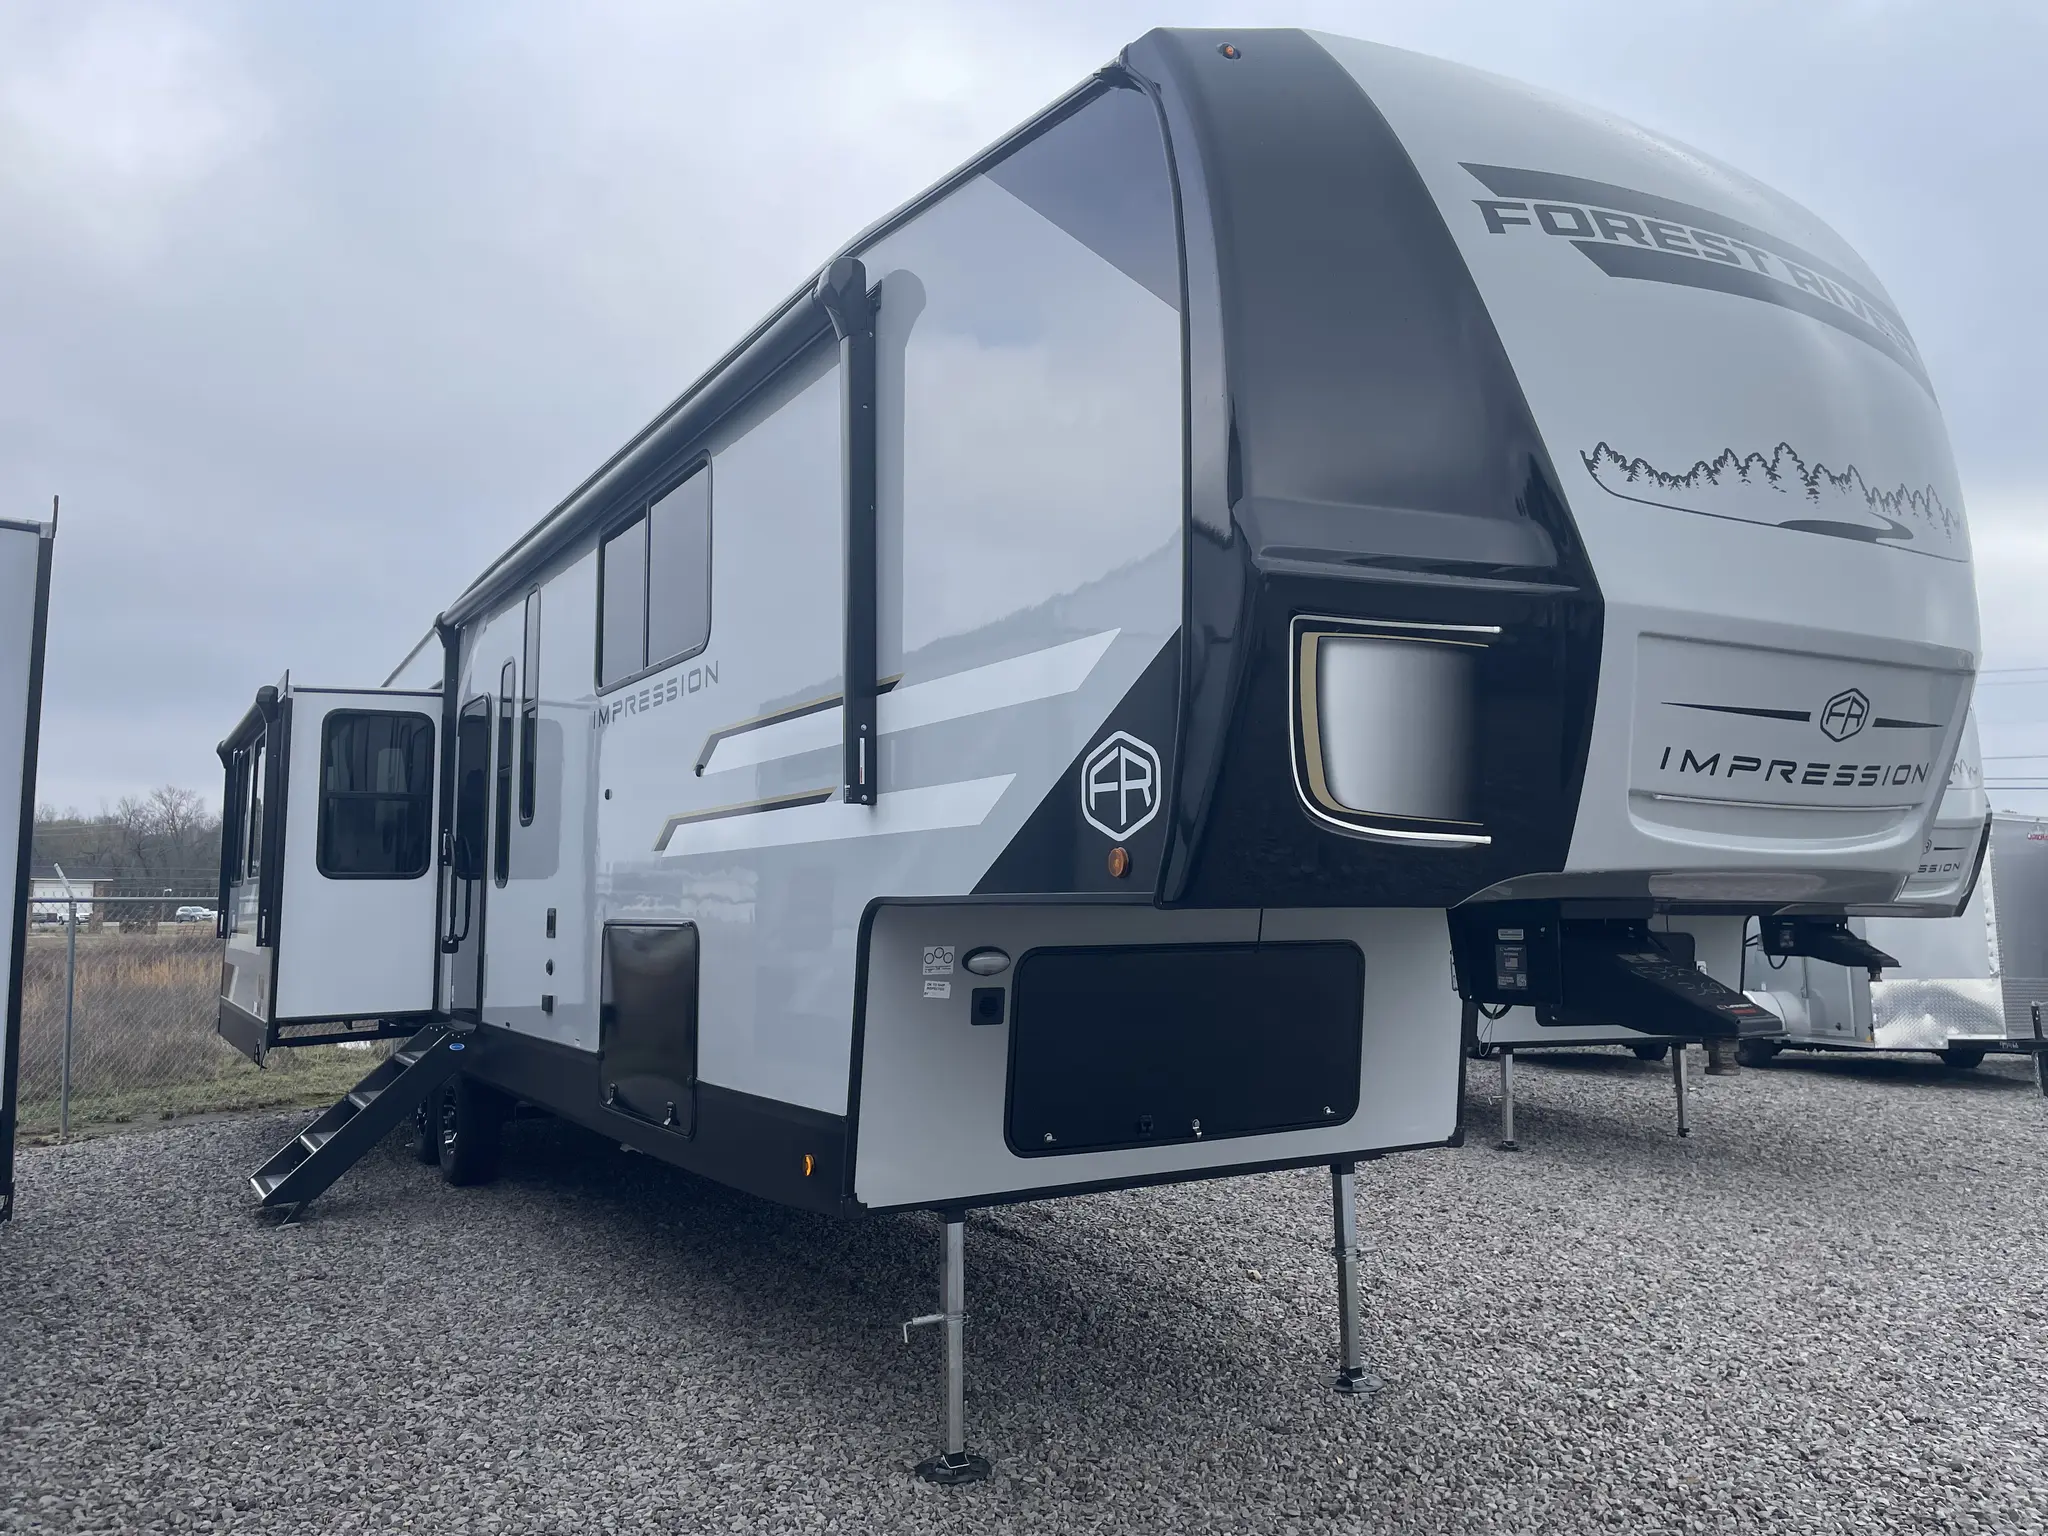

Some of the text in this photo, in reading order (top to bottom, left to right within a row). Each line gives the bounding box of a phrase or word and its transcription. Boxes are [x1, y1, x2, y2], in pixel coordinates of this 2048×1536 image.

[1470, 199, 1918, 365] FOREST RIVER
[593, 660, 719, 729] IMPRESSION
[1659, 746, 1930, 787] IMPRESSION
[1917, 861, 1961, 873] SSION
